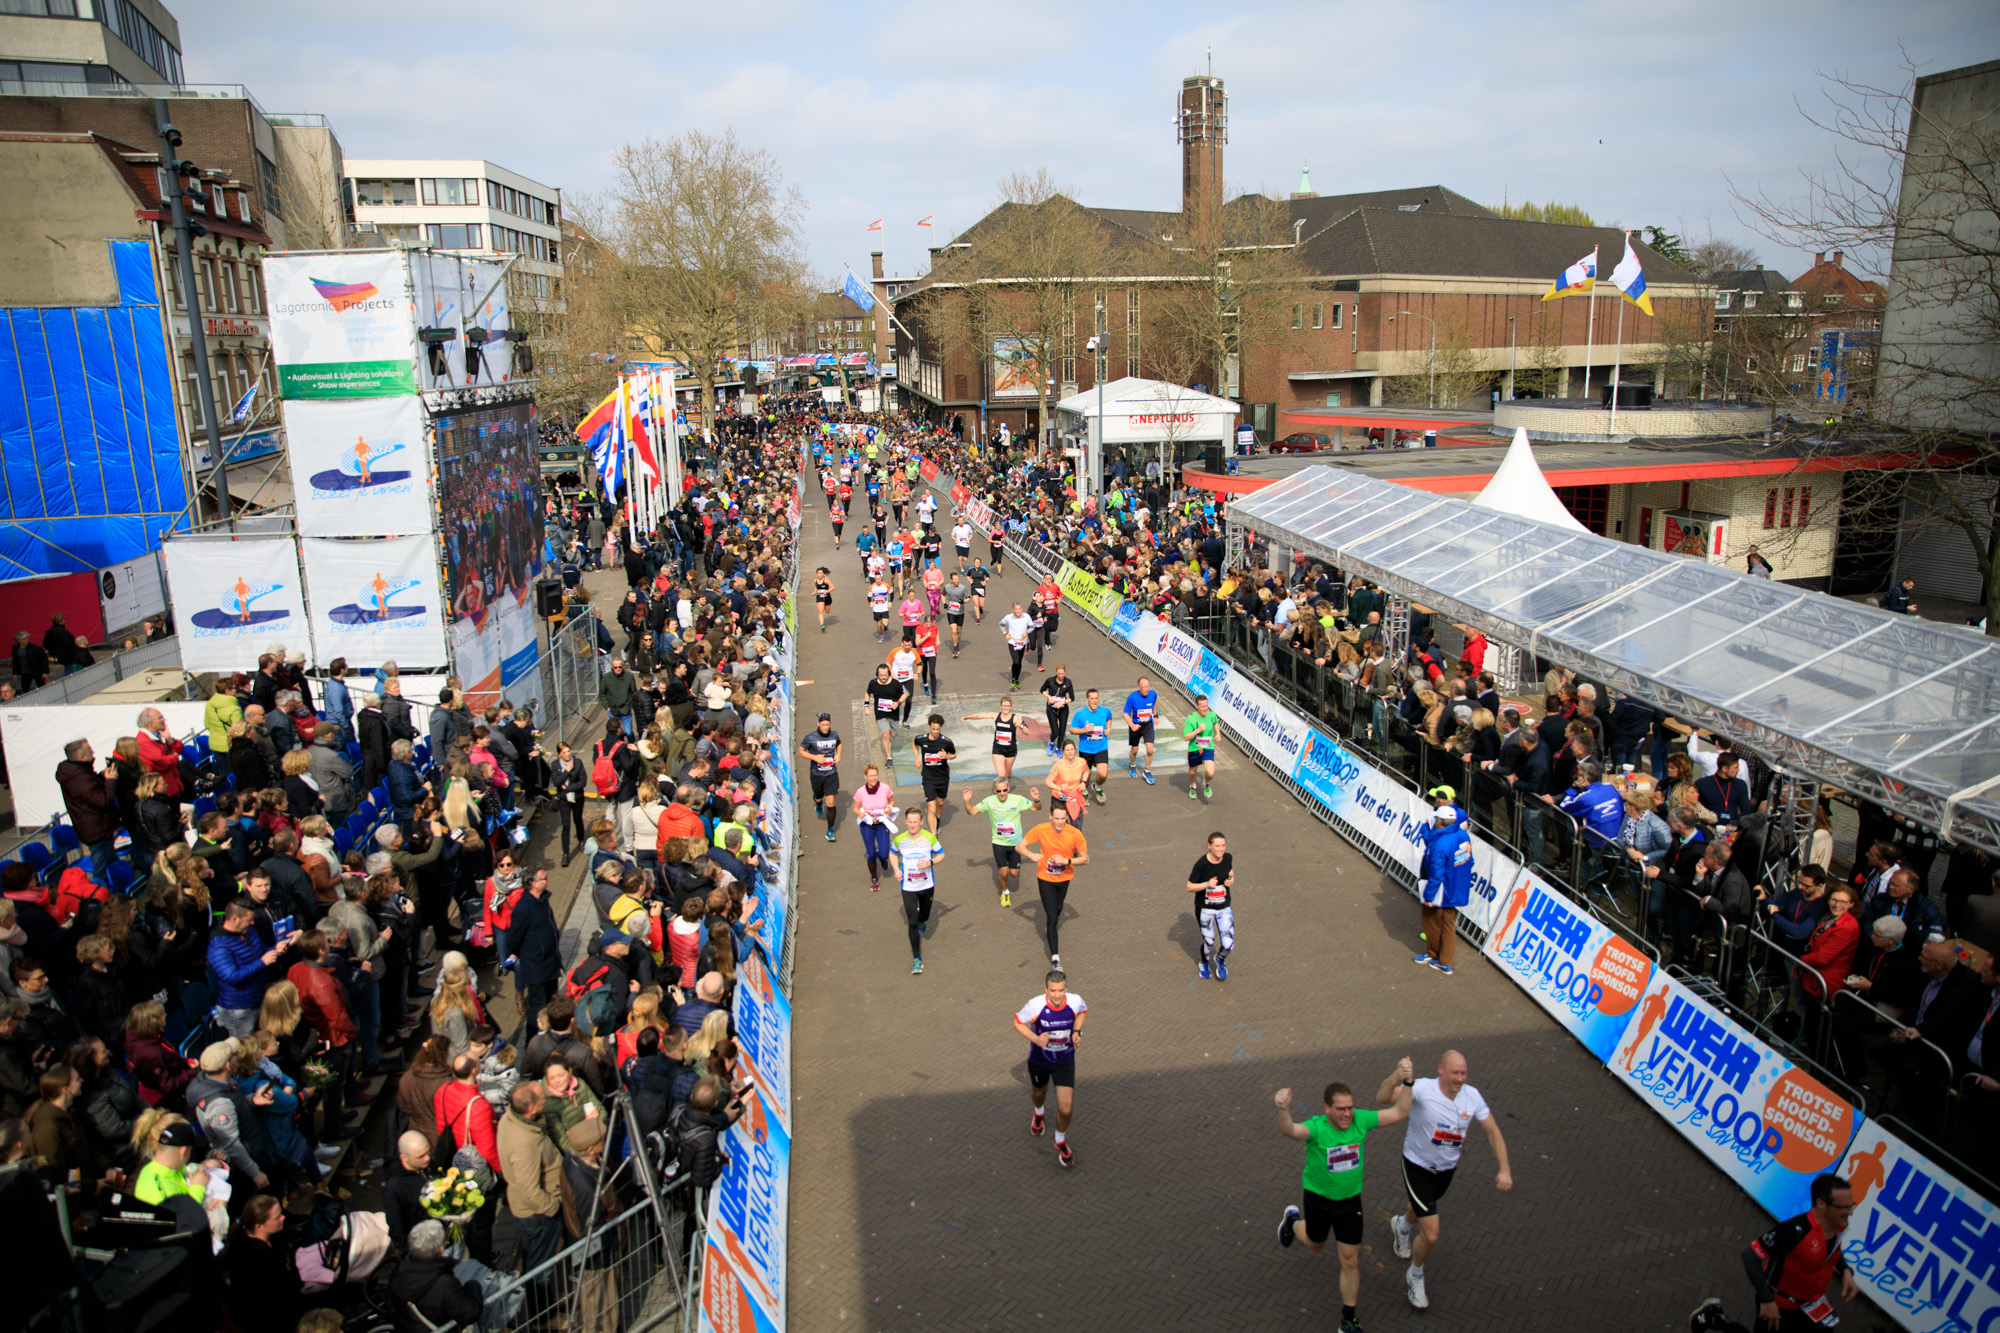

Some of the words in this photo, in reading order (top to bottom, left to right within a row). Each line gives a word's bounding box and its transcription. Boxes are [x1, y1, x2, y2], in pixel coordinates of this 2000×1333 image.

[276, 302, 339, 315] Lagotronics
[343, 299, 394, 312] Projects
[292, 372, 332, 382] Audiovisual
[334, 372, 339, 380] &
[340, 371, 370, 381] Lighting
[371, 370, 404, 378] solutions
[338, 380, 380, 389] experiences
[1139, 414, 1194, 424] NEPTUNUS
[1066, 571, 1103, 608] AutoArena
[1164, 653, 1188, 675] LOGISTICS
[1170, 636, 1196, 662] SEACON
[1200, 655, 1228, 684] VENLOOP
[1221, 683, 1233, 703] Van
[1232, 692, 1244, 712] der
[1244, 700, 1260, 725] Valk
[1258, 712, 1279, 739] Hotel
[1276, 724, 1298, 756] Venlo
[1310, 738, 1360, 782] VENLOOP
[1354, 784, 1376, 813] Van
[1376, 798, 1398, 826] der
[1398, 812, 1424, 848] Valk
[1470, 871, 1498, 902] enlo
[1521, 887, 1592, 961] WEIR
[1511, 921, 1603, 1010] VENLOOP
[1600, 958, 1638, 984] HOOFD-
[1606, 944, 1646, 973] TROTSE
[1498, 942, 1539, 979] Beleef
[1530, 975, 1549, 991] je
[1550, 986, 1596, 1022] samen!
[1590, 968, 1639, 1000] SPONSOR
[761, 991, 779, 1090] VENLOOP
[1659, 994, 1761, 1095] WEIR
[1628, 1061, 1693, 1110] Beleef
[1677, 1105, 1703, 1127] je
[1706, 1123, 1775, 1176] samen!
[1648, 1034, 1784, 1159] VENLOOP
[1776, 1096, 1834, 1134] HOOFD-
[1783, 1080, 1844, 1122] TROTSE
[1764, 1108, 1838, 1156] SPONSOR
[120, 1211, 156, 1220] SHURE
[748, 1127, 774, 1272] VENLOOP
[710, 1253, 720, 1324] TROTSE
[1841, 1240, 1937, 1316] Beleef
[729, 1271, 740, 1333] ONSOR
